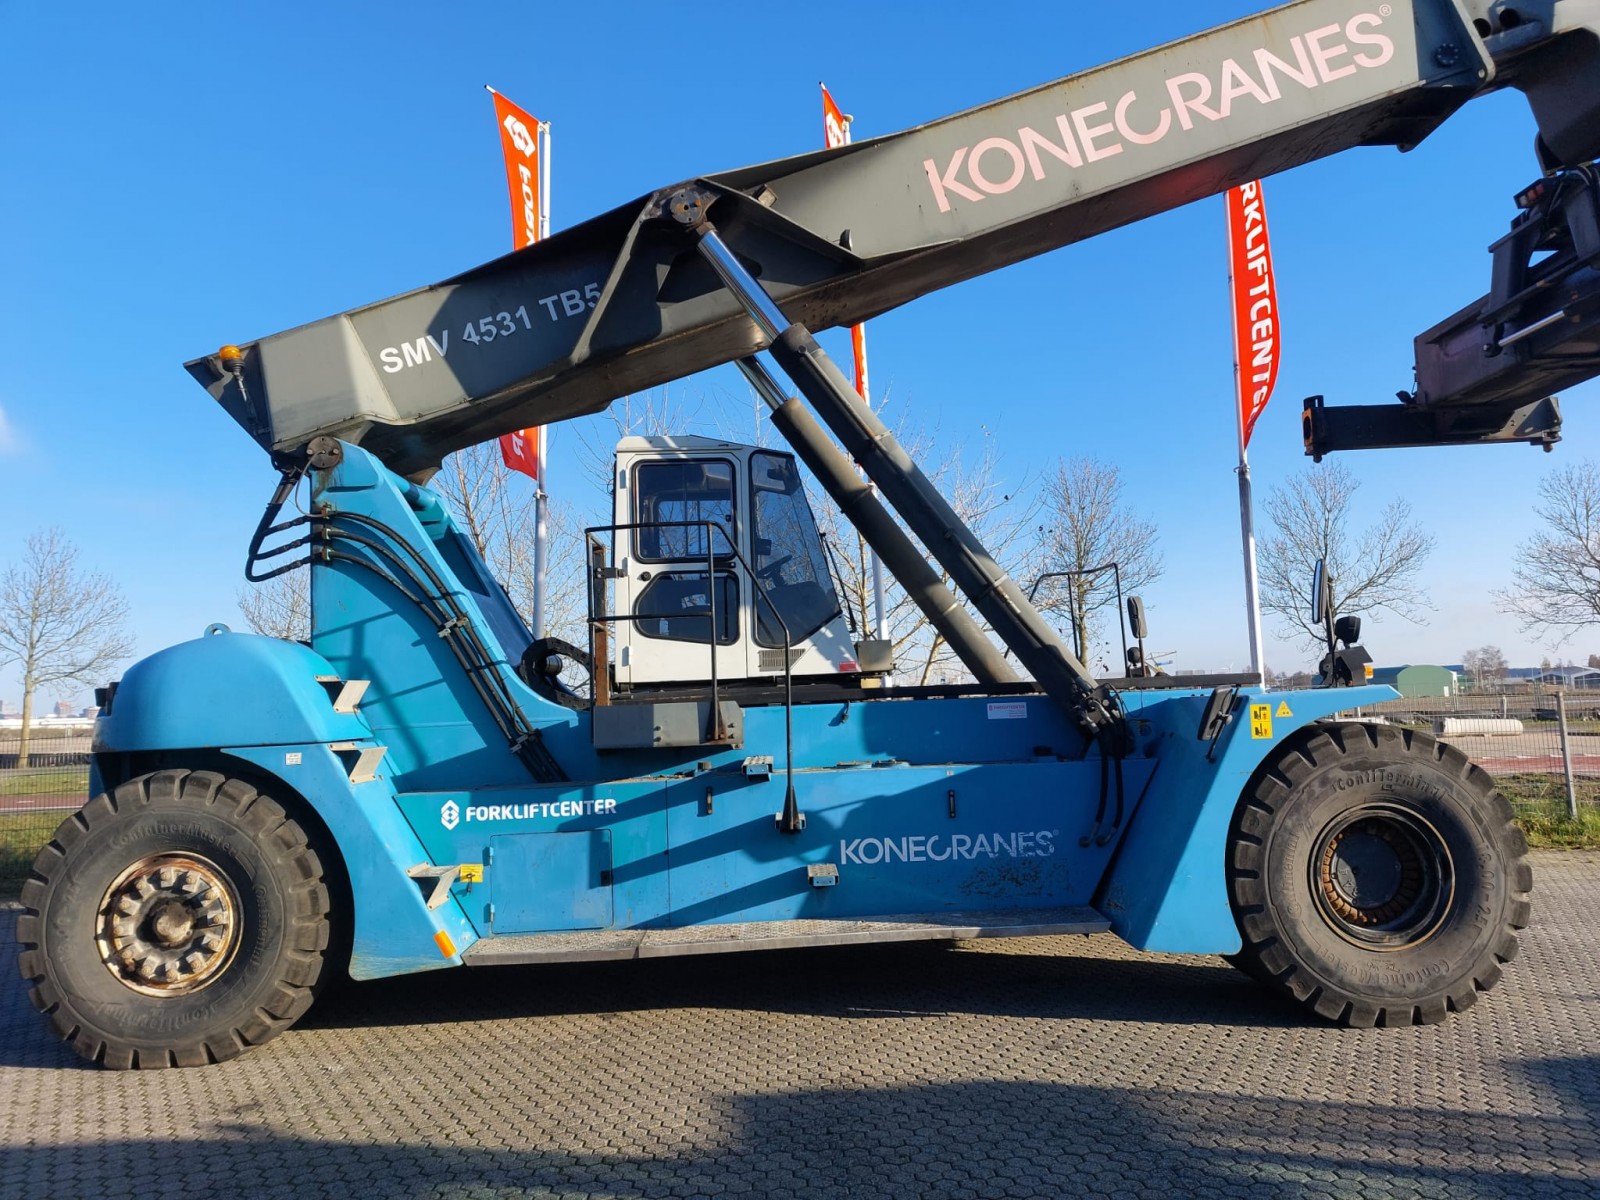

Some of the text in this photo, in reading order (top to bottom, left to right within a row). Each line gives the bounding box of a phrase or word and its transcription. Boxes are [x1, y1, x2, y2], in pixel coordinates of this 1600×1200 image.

[379, 282, 601, 374] SMV 4531 TB5
[465, 799, 617, 822] FORKLIFTCENTER
